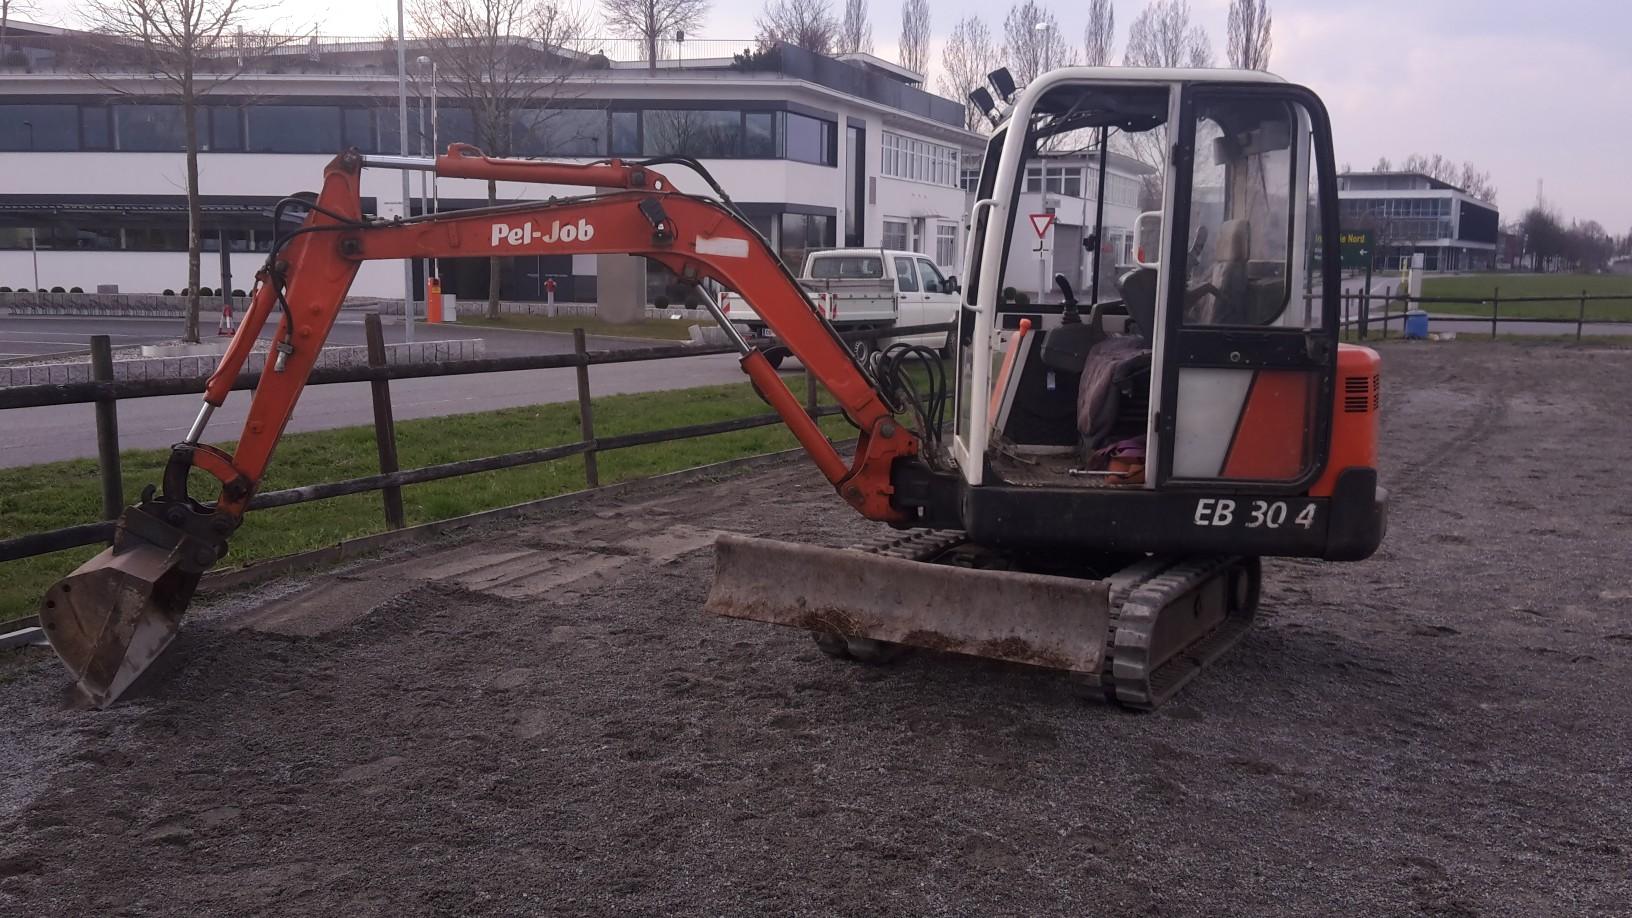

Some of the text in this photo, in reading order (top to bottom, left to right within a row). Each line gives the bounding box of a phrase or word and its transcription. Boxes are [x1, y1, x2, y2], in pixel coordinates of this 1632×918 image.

[491, 218, 595, 247] Pel-Job
[1194, 498, 1317, 530] EB 30 4
